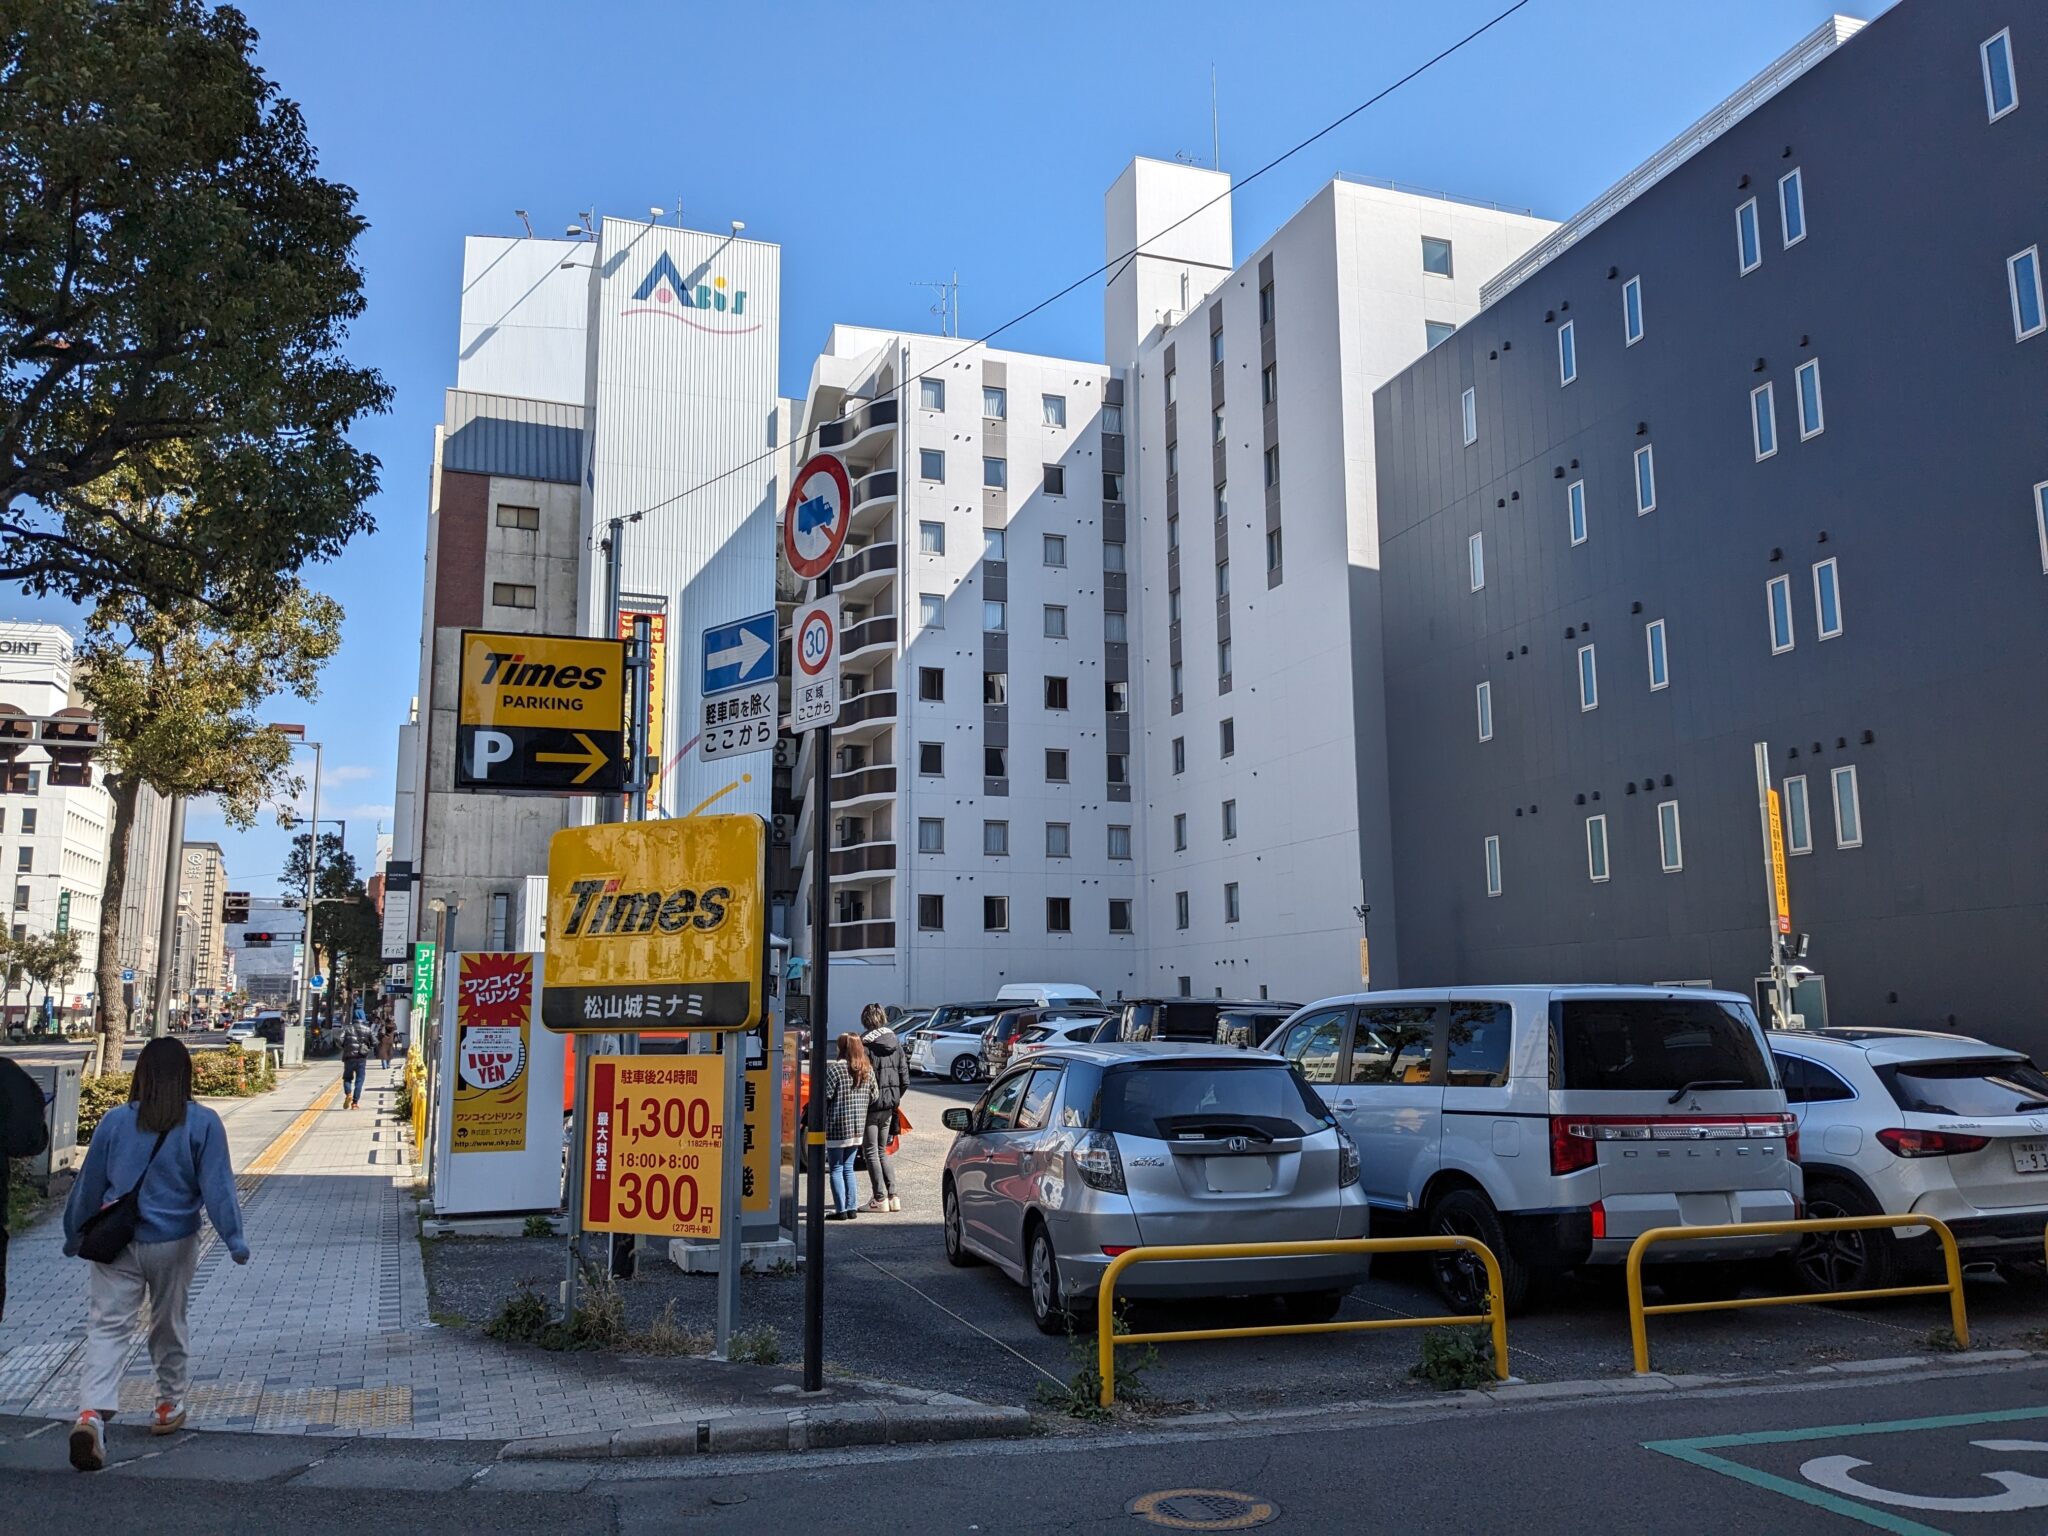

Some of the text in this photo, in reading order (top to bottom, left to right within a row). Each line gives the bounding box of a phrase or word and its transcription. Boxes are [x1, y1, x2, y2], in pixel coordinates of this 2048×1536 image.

[805, 626, 826, 658] 30
[481, 652, 607, 690] Times
[502, 695, 584, 711] PARKING
[805, 685, 825, 703] 区域
[705, 693, 771, 726] 軽車両を除く
[798, 700, 832, 721] ここから
[705, 722, 772, 753] ここから
[472, 730, 514, 779] P
[564, 879, 731, 934] Times
[465, 972, 526, 993] ワンコイン
[475, 986, 520, 1007] ドリンク
[584, 994, 703, 1019] 松山城ミナミ
[477, 1064, 506, 1084] YEN
[620, 1069, 698, 1085] 駐車後24時間
[456, 1111, 523, 1122] ワンコインドリンク
[454, 1139, 523, 1148] http://www.nky.bz/
[595, 1111, 609, 1172] 最大料金
[619, 1153, 699, 1170] 18:00 8:00
[1623, 1147, 1775, 1158] DELICA
